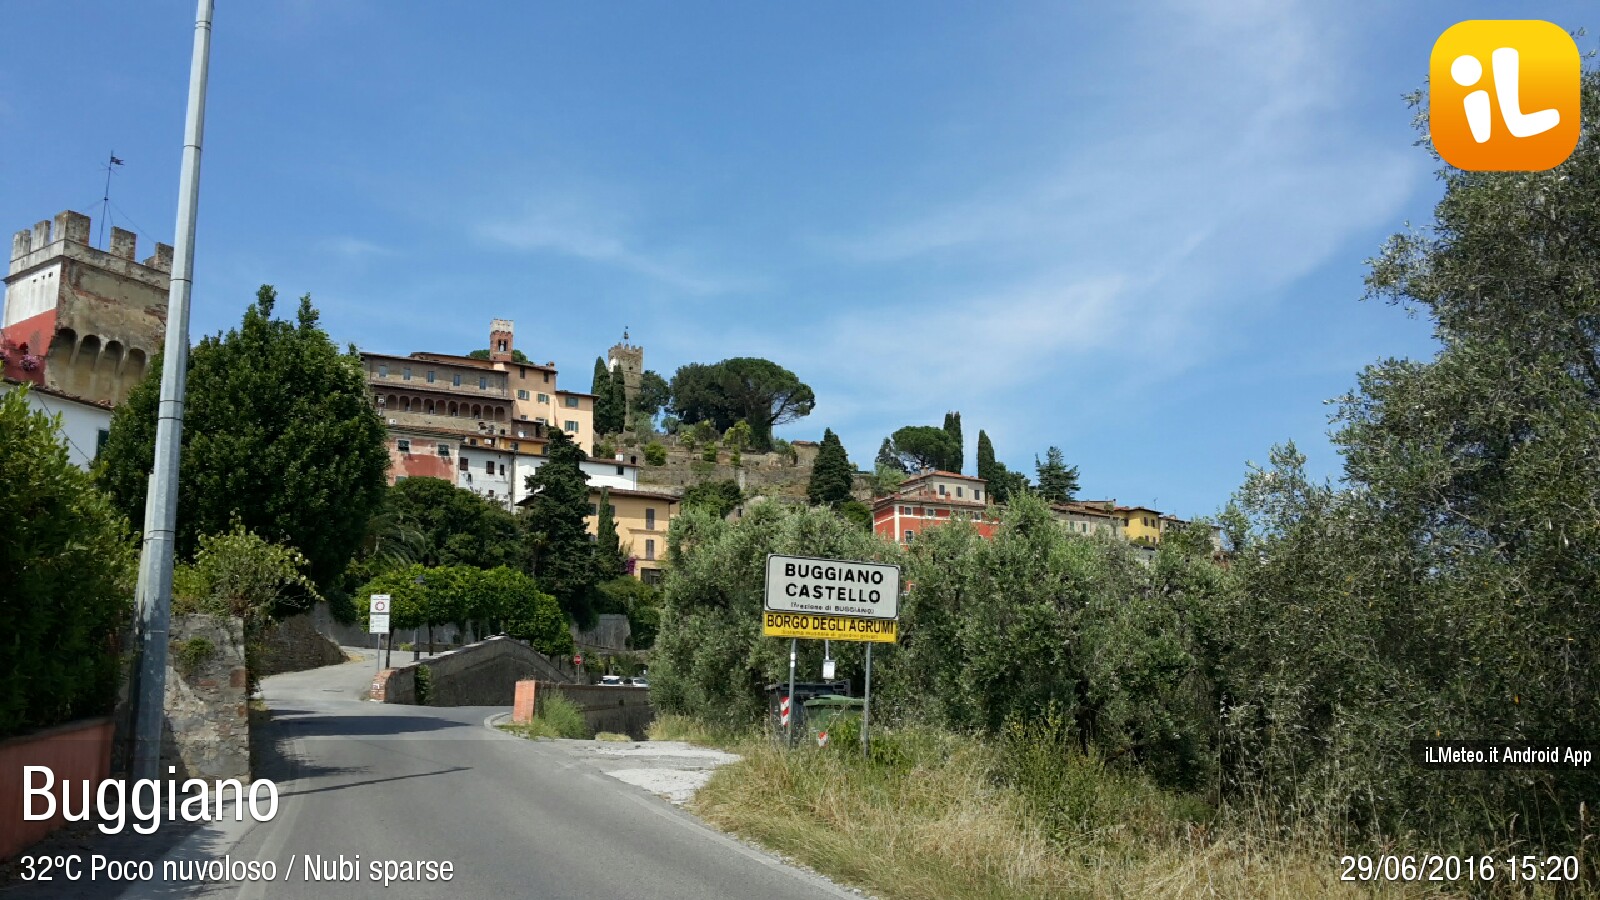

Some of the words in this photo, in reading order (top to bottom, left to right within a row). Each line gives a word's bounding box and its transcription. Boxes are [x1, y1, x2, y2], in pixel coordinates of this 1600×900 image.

[785, 563, 883, 584] BUGGIANO
[785, 583, 880, 603] CASTELLO
[767, 614, 809, 629] BORGO
[812, 617, 846, 631] DEGLI
[849, 619, 893, 634] AGRUMI
